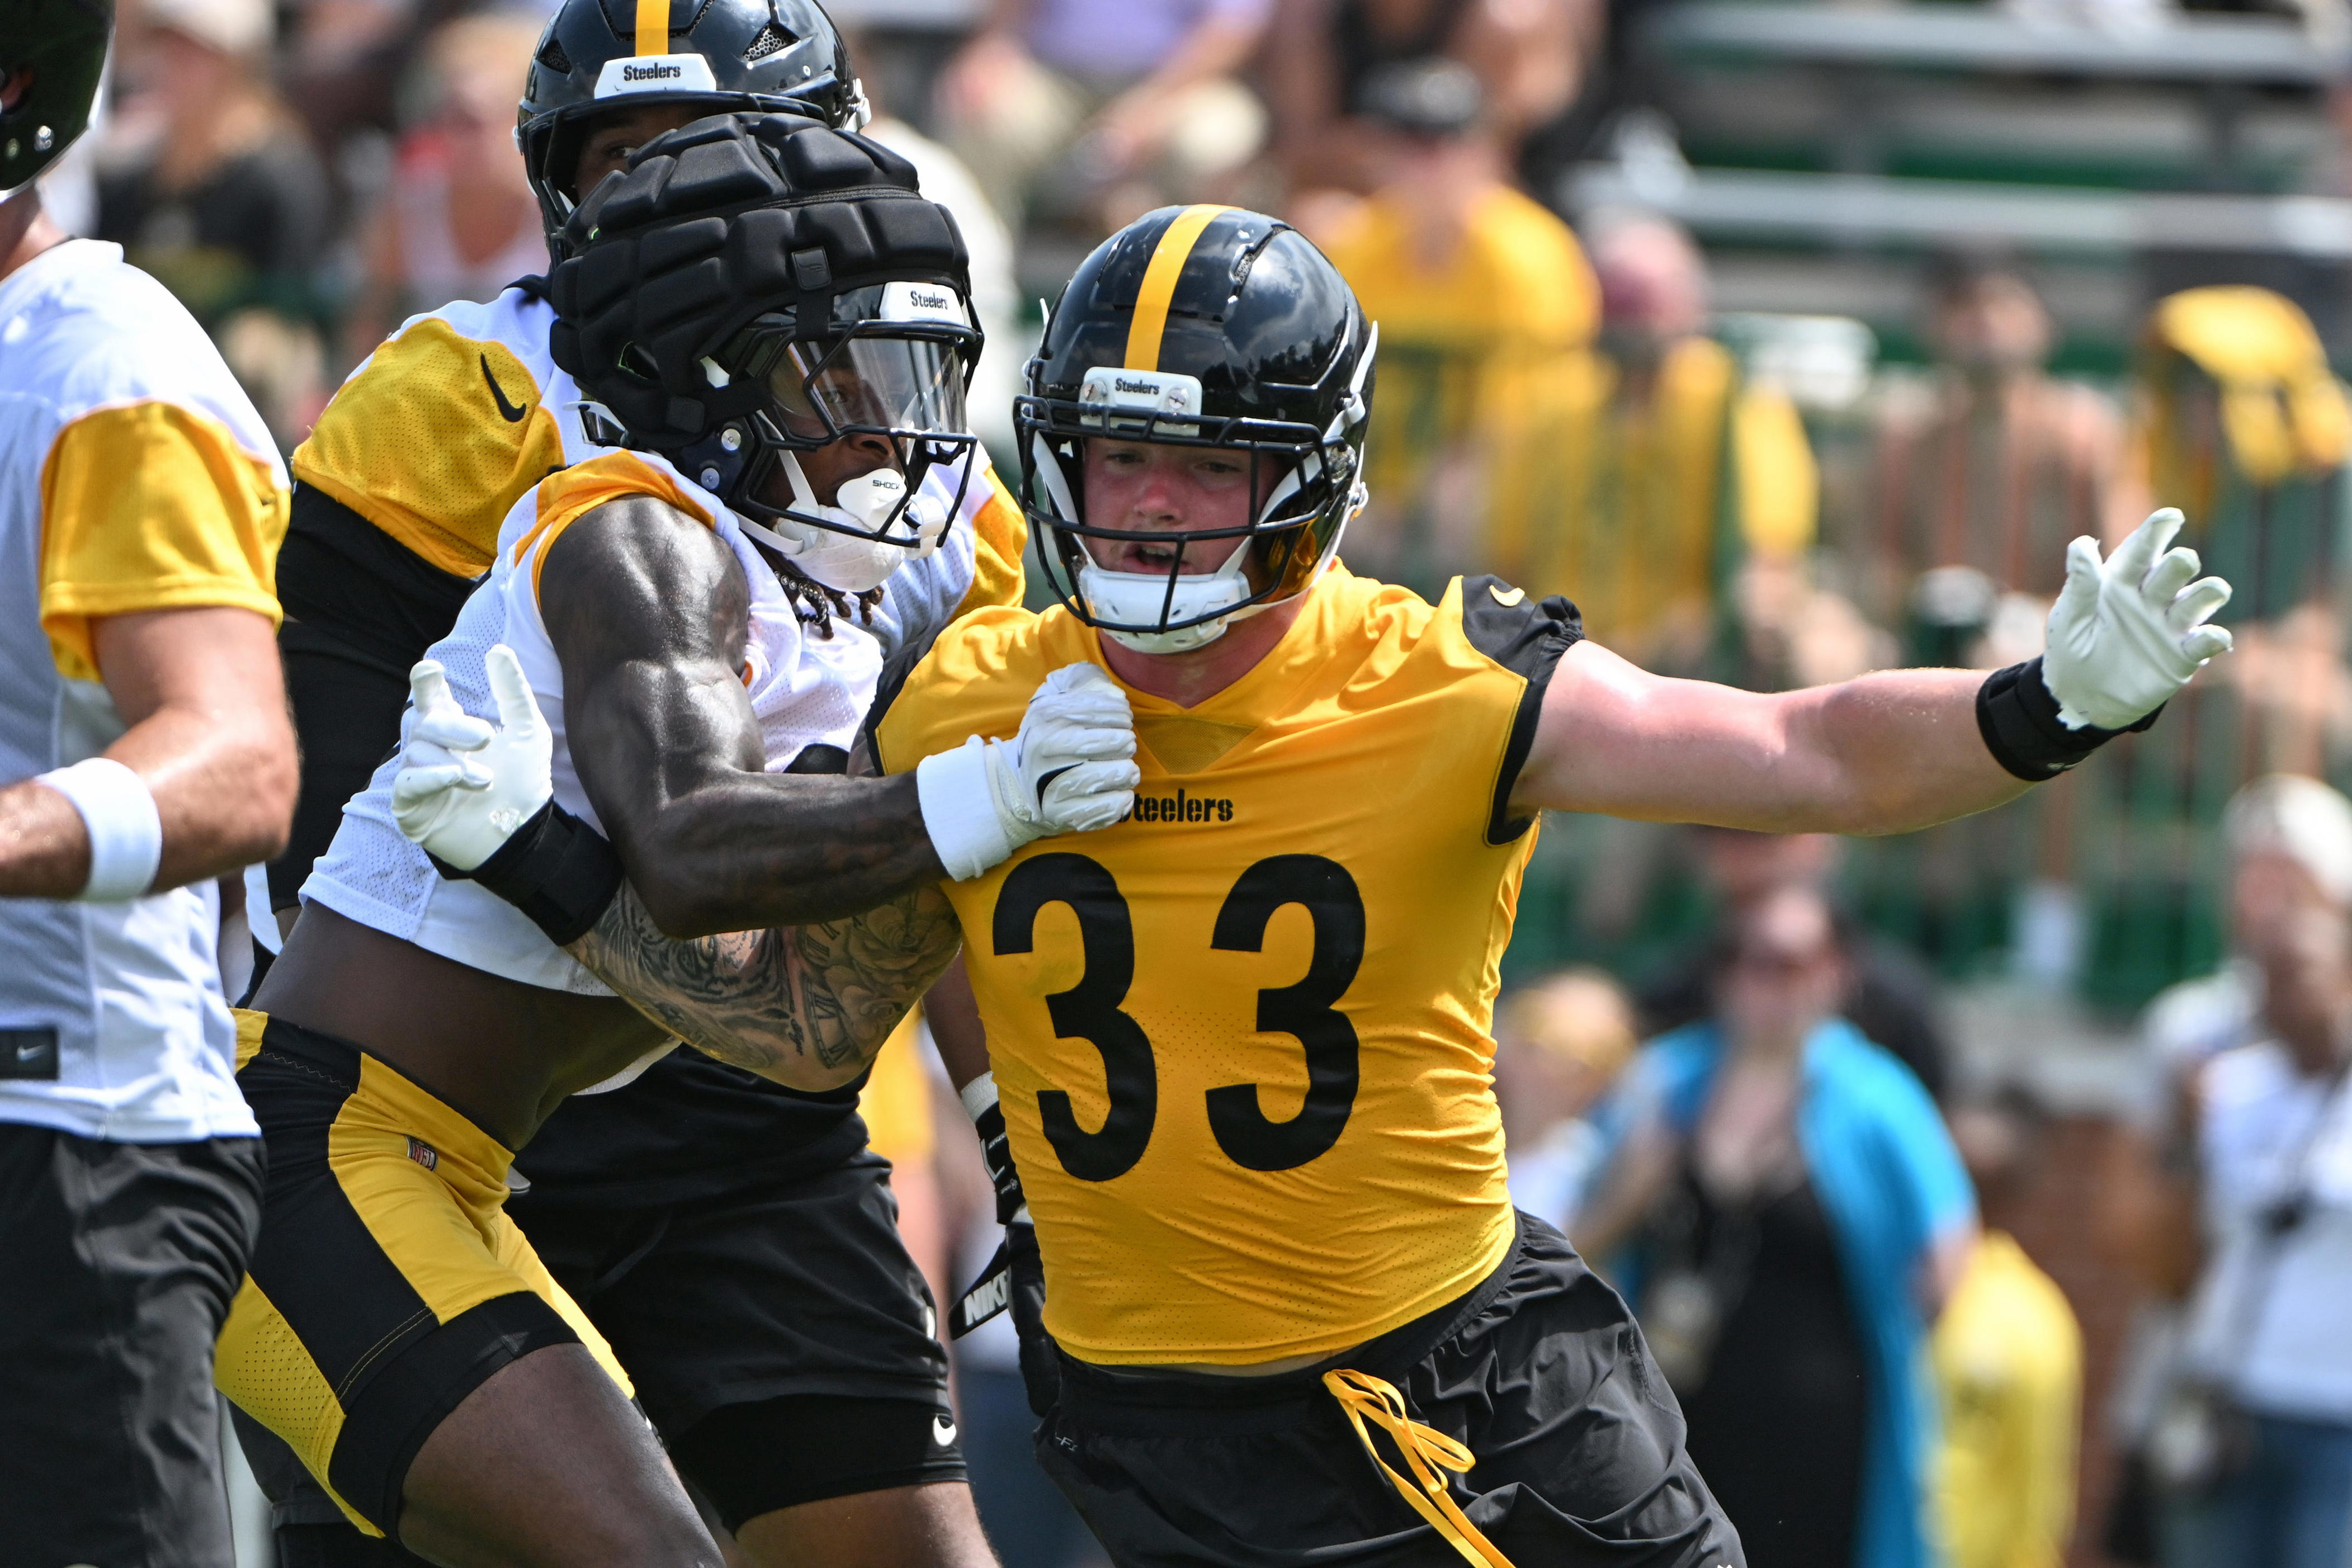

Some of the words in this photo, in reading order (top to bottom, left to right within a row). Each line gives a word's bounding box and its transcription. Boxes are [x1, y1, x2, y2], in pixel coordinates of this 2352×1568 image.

[623, 62, 681, 82] Steelers
[910, 290, 948, 310] Steelers
[1115, 377, 1160, 395] Steelers
[872, 479, 900, 490] SHOCK
[413, 1144, 433, 1170] NFL
